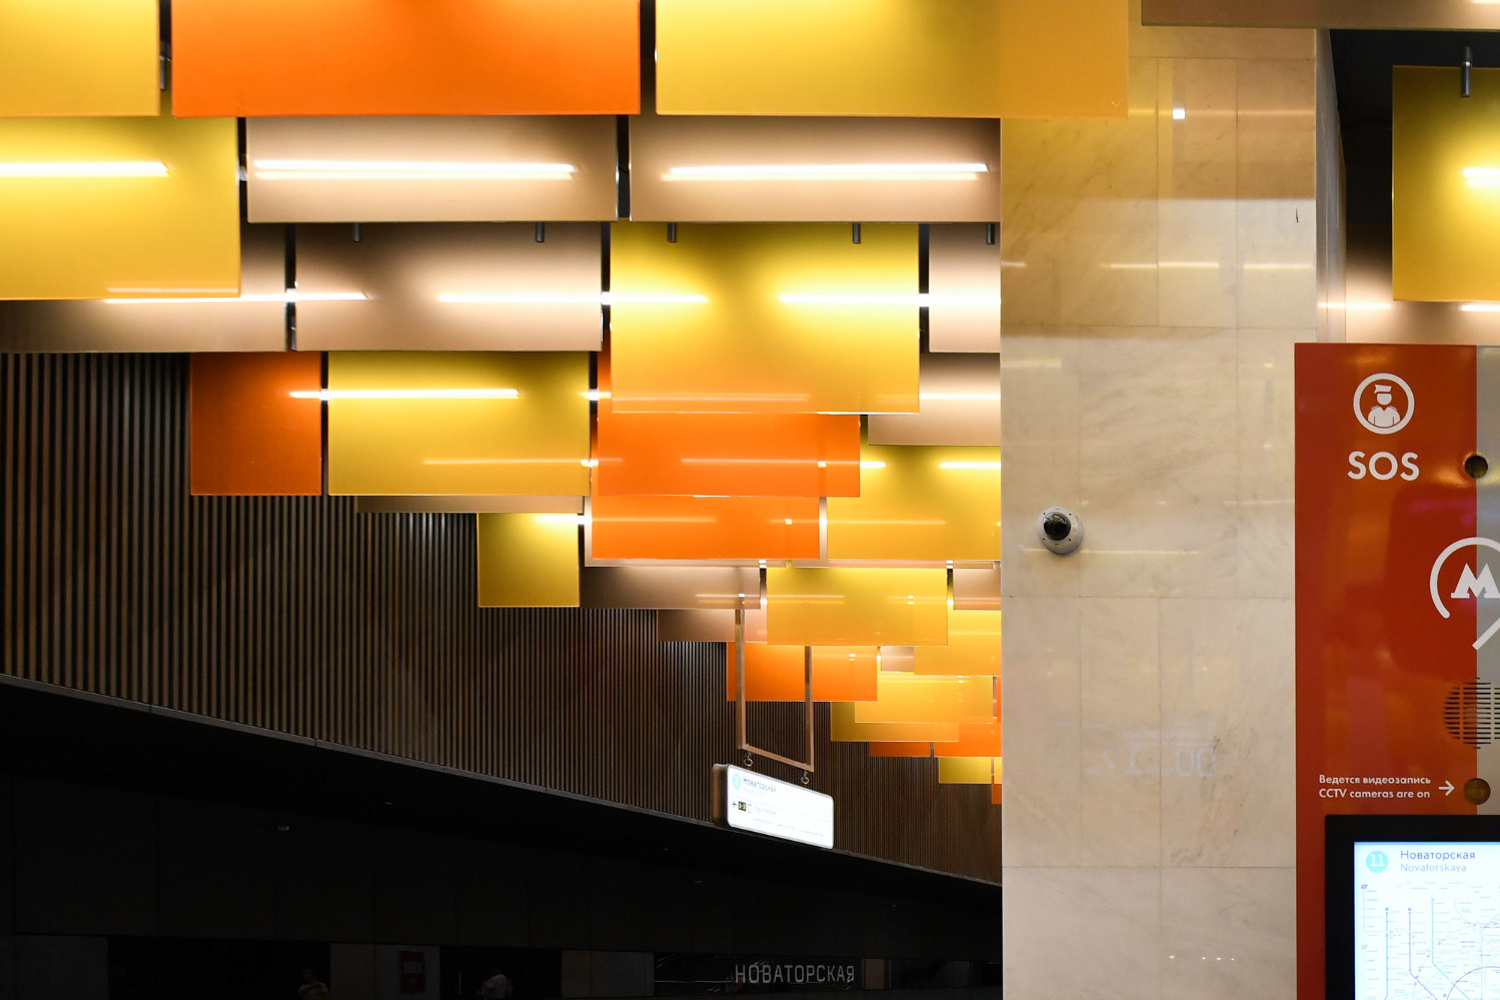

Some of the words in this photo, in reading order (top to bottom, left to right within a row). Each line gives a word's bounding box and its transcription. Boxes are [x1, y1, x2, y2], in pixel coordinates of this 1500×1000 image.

[1347, 450, 1420, 481] SOS
[1319, 774, 1361, 787] Ведется
[1363, 775, 1431, 787] видеозапись
[1319, 788, 1347, 799] CCTV
[1349, 790, 1394, 799] cameras
[1396, 790, 1414, 799] are
[1416, 790, 1430, 799] on
[1369, 853, 1385, 867] 11
[1400, 849, 1476, 862] Новаторская
[1400, 863, 1467, 873] Novatorskaya
[735, 964, 855, 984] НОВАТОРСКАЯ
